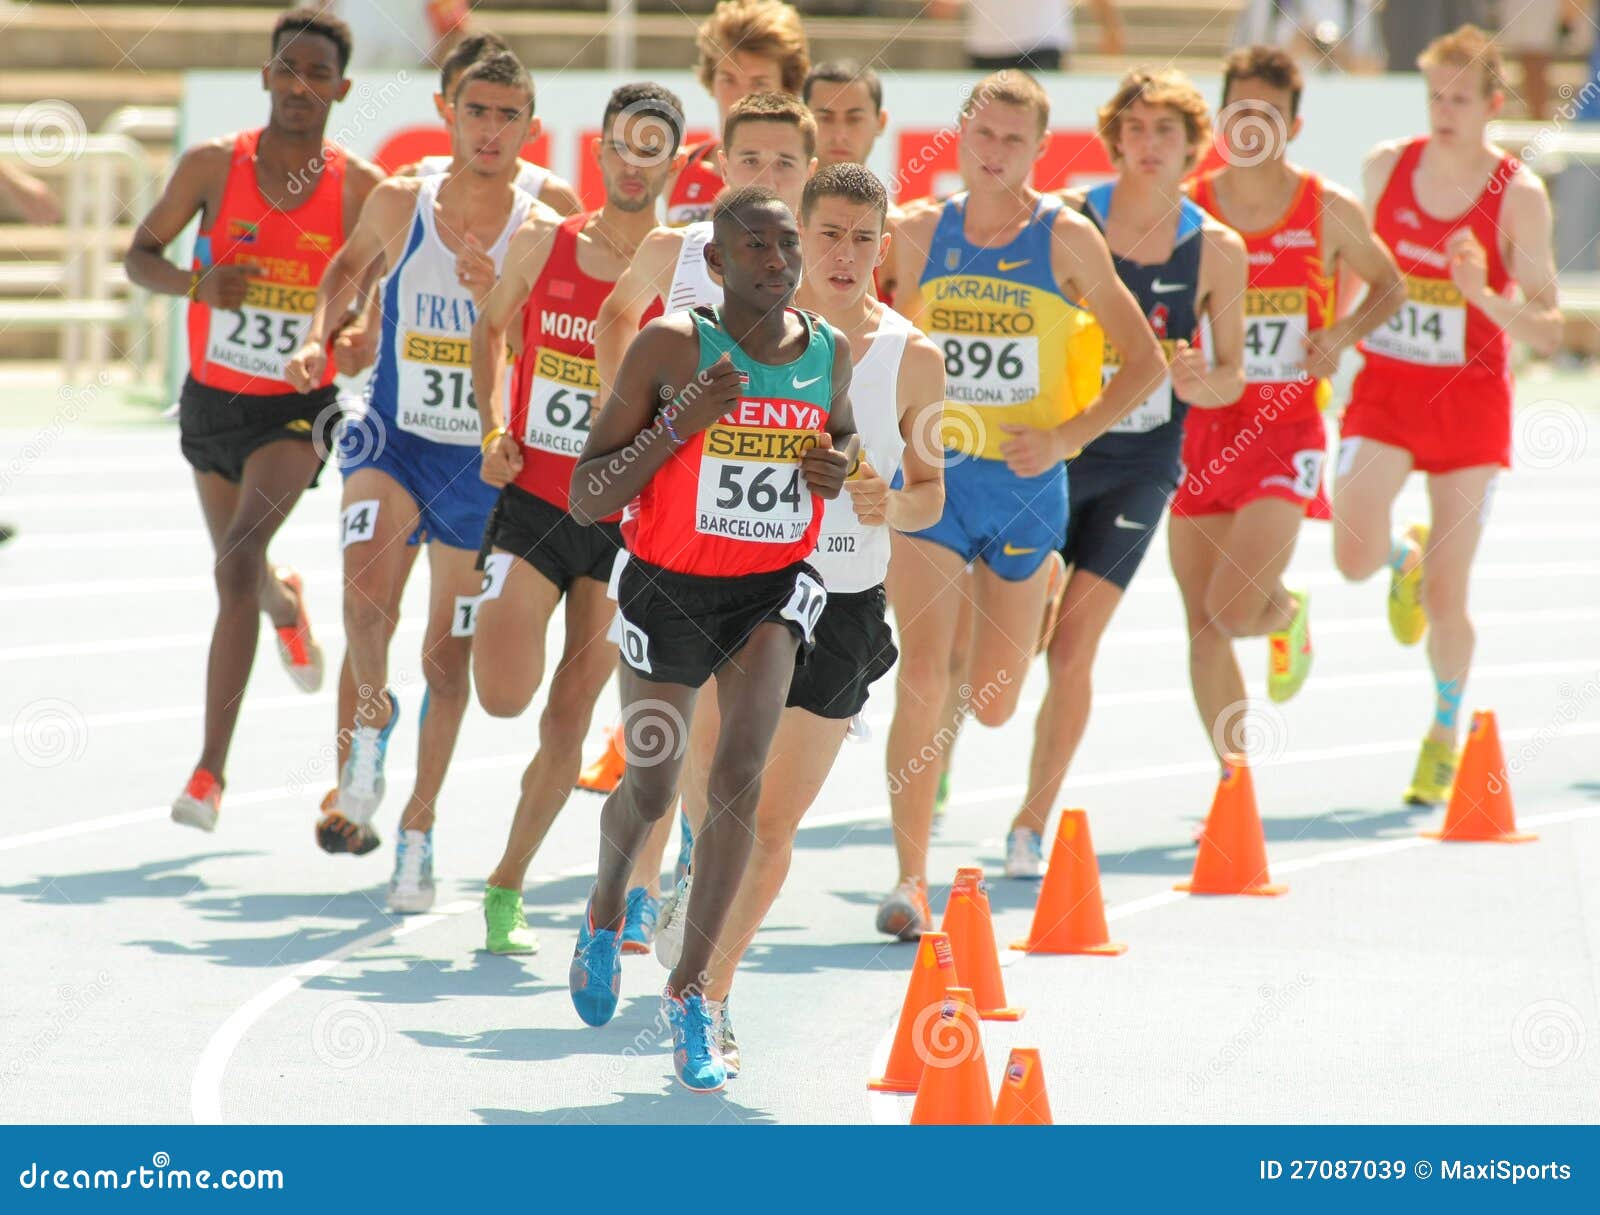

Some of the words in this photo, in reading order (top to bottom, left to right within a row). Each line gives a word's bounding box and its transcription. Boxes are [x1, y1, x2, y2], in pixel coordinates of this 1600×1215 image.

[228, 310, 300, 354] 235
[931, 307, 1034, 335] SEIKO
[213, 345, 280, 376] BARCELONA
[407, 337, 472, 364] SEI
[943, 339, 1024, 380] 896
[539, 353, 600, 388] SEI
[403, 411, 479, 432] BARCELONA
[709, 429, 818, 459] SEIKO
[716, 464, 801, 513] 564
[700, 514, 784, 539] BARCELONA
[827, 536, 855, 552] 2012
[796, 580, 824, 631] 10
